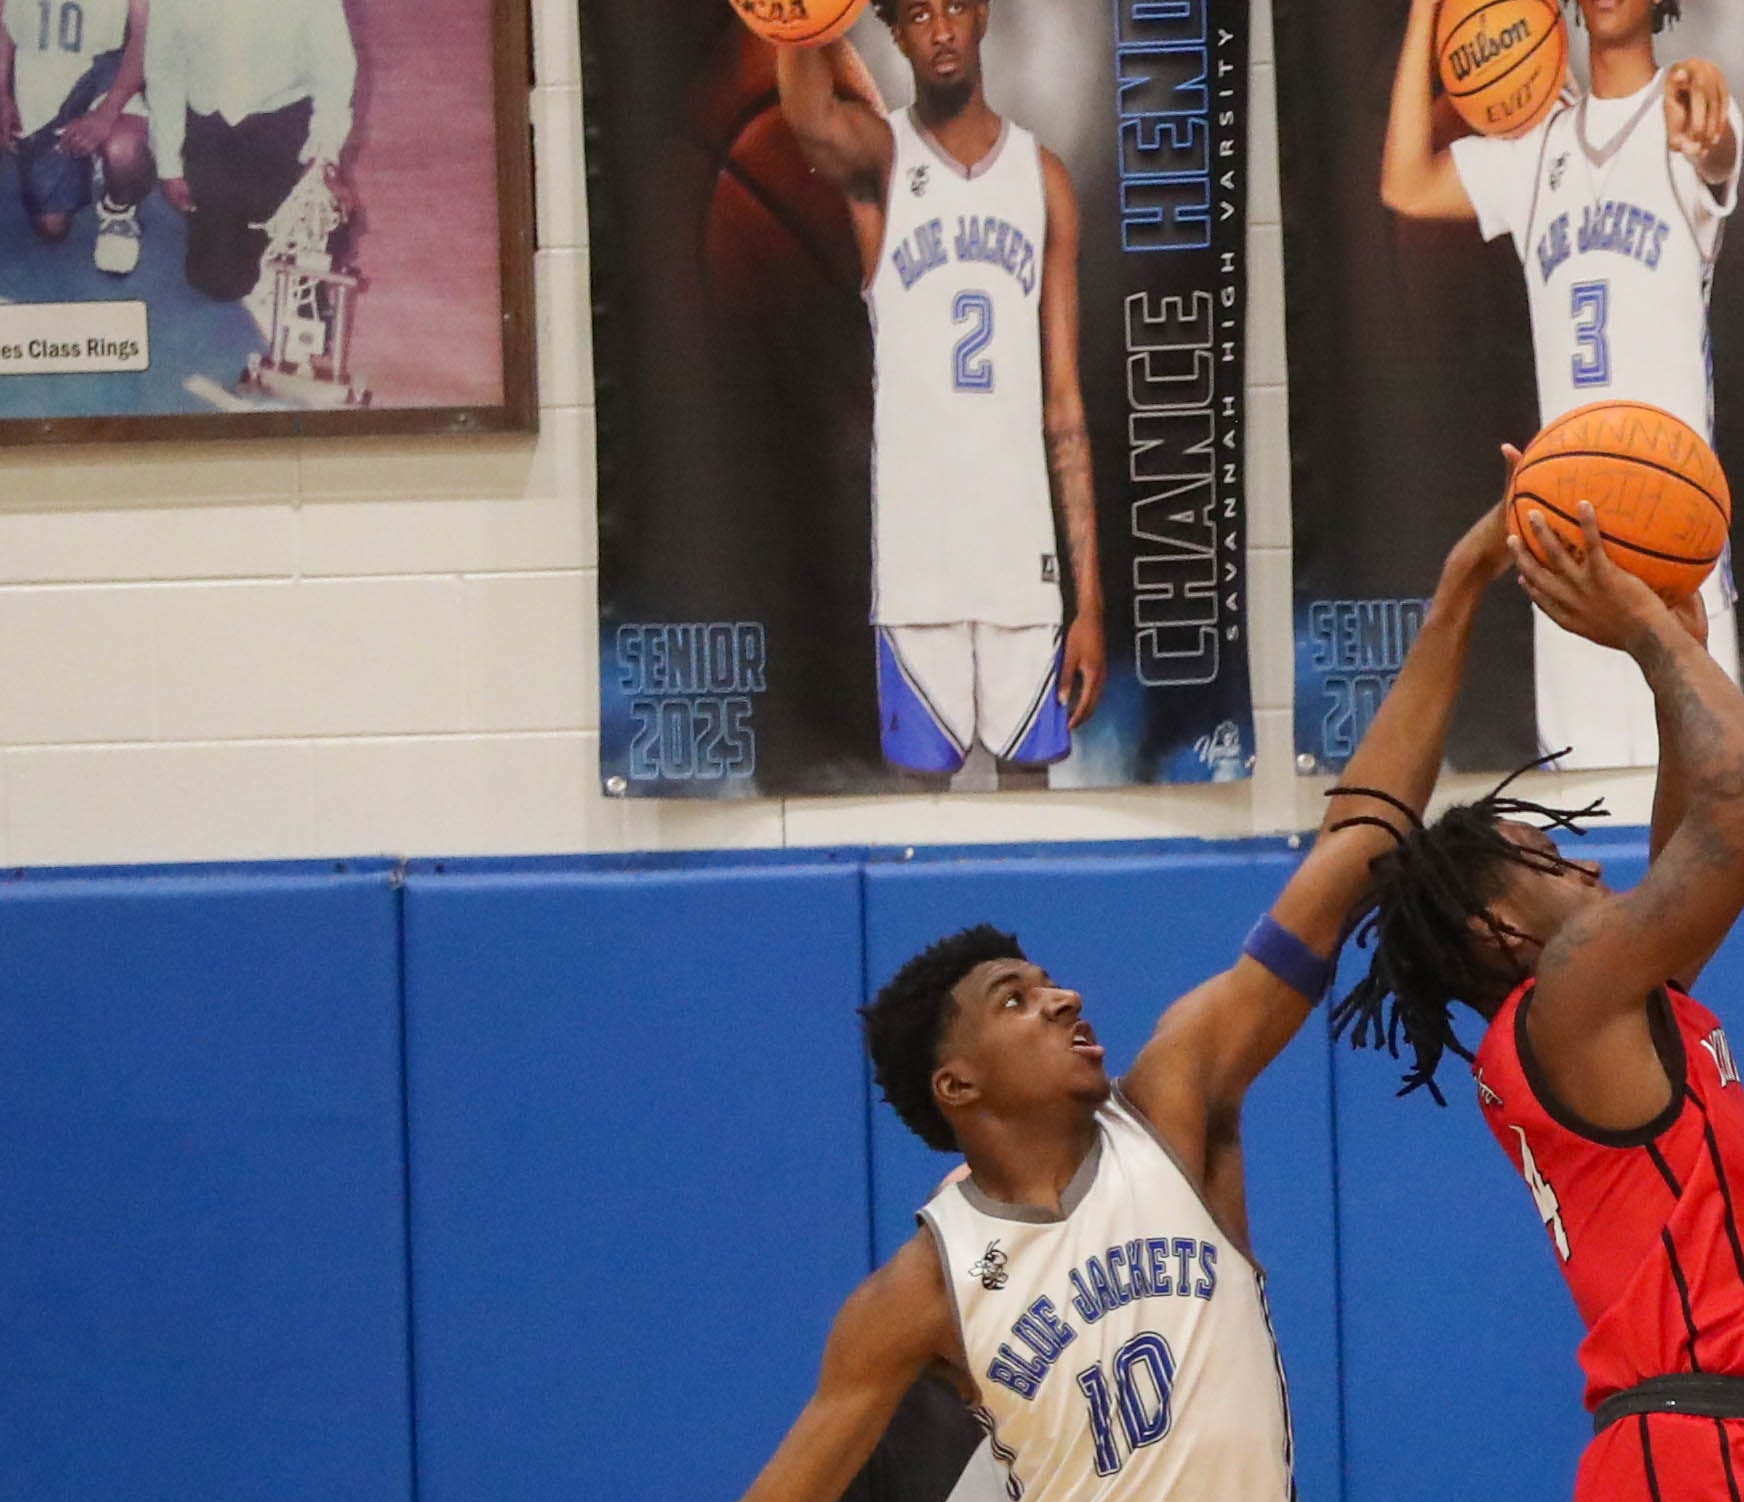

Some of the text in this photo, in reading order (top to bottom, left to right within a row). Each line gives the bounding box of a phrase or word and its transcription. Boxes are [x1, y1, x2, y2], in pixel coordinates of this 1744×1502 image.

[37, 0, 83, 53] 10
[891, 214, 1036, 298] BLUE JACKETS
[1577, 200, 1672, 272] JACKETS
[28, 338, 81, 359] Class
[86, 337, 140, 361] Rings
[951, 288, 994, 394] 2
[1217, 27, 1240, 642] SAVANNAH HIGH VARSITY
[1570, 278, 1611, 389] 3
[1124, 289, 1220, 688] CHANCE
[616, 621, 767, 696] SENIOR
[1308, 598, 1435, 672] SENIO
[629, 696, 756, 780] 2025
[986, 1237, 1218, 1401] BLUE JACKETS
[1076, 1330, 1177, 1478] 10
